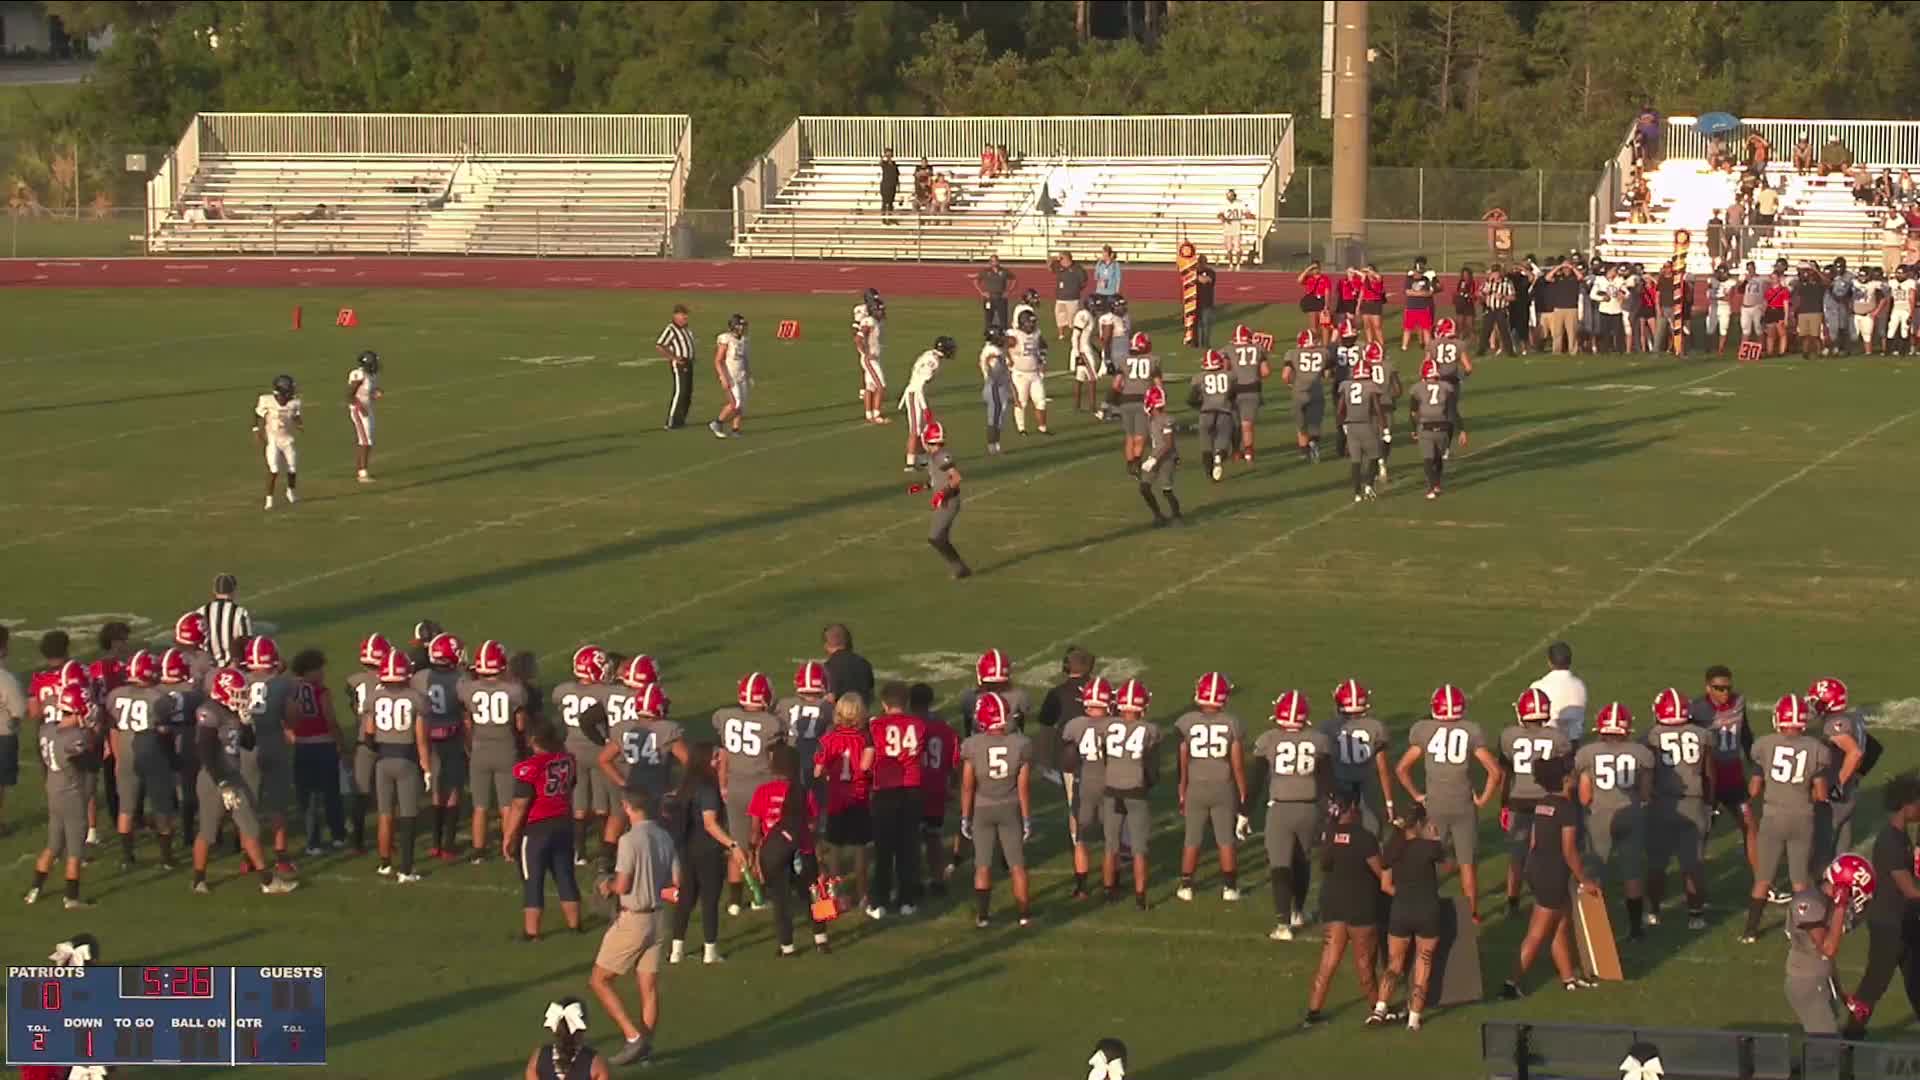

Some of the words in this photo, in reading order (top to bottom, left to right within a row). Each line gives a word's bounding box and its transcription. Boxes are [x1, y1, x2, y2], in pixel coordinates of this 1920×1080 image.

[1126, 358, 1150, 379] 70
[1235, 346, 1257, 366] 77
[1299, 352, 1323, 372] 52
[1336, 345, 1360, 367] 55
[1437, 343, 1457, 363] 13
[1204, 373, 1228, 394] 90
[1350, 382, 1363, 405] 2
[1427, 384, 1440, 405] 7
[115, 697, 149, 732] 79
[374, 697, 413, 731] 80
[472, 690, 510, 724] 30
[788, 704, 820, 739] 17
[622, 731, 660, 764] 54
[724, 718, 762, 757] 65
[885, 724, 918, 757] 94
[1105, 722, 1147, 760] 24
[1189, 723, 1229, 758] 25
[1337, 729, 1372, 764] 16
[1426, 727, 1469, 764] 40
[1660, 731, 1701, 765] 56
[840, 748, 852, 781] 1
[988, 746, 1008, 780] 5
[1275, 740, 1316, 776] 26
[1594, 753, 1636, 791] 50
[1770, 745, 1808, 784] 51
